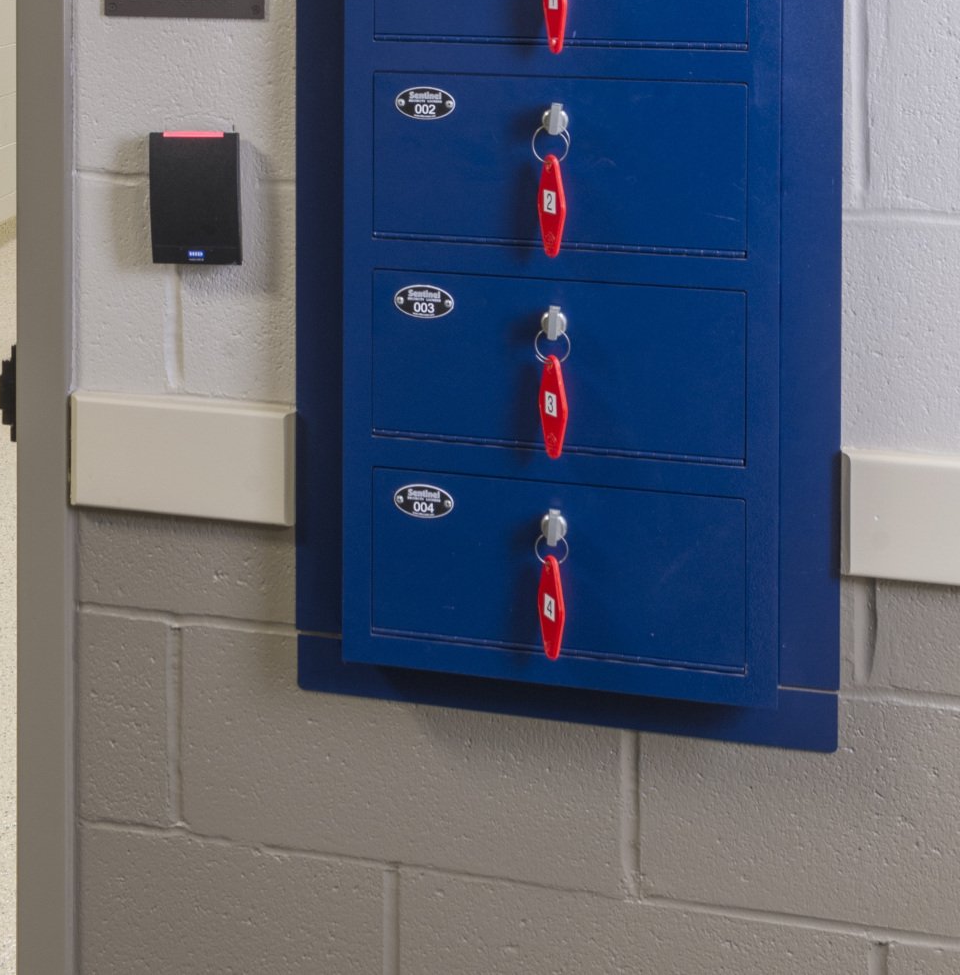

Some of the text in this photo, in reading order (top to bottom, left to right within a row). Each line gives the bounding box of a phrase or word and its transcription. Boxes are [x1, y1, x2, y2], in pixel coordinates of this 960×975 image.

[408, 90, 442, 100] Sentinel
[414, 103, 436, 115] 002
[546, 193, 553, 211] 2
[407, 289, 441, 299] Sentinel
[413, 302, 435, 314] 003
[547, 395, 554, 413] 3
[407, 488, 441, 499] Sentinel
[413, 501, 435, 514] 004
[546, 600, 553, 617] 4
